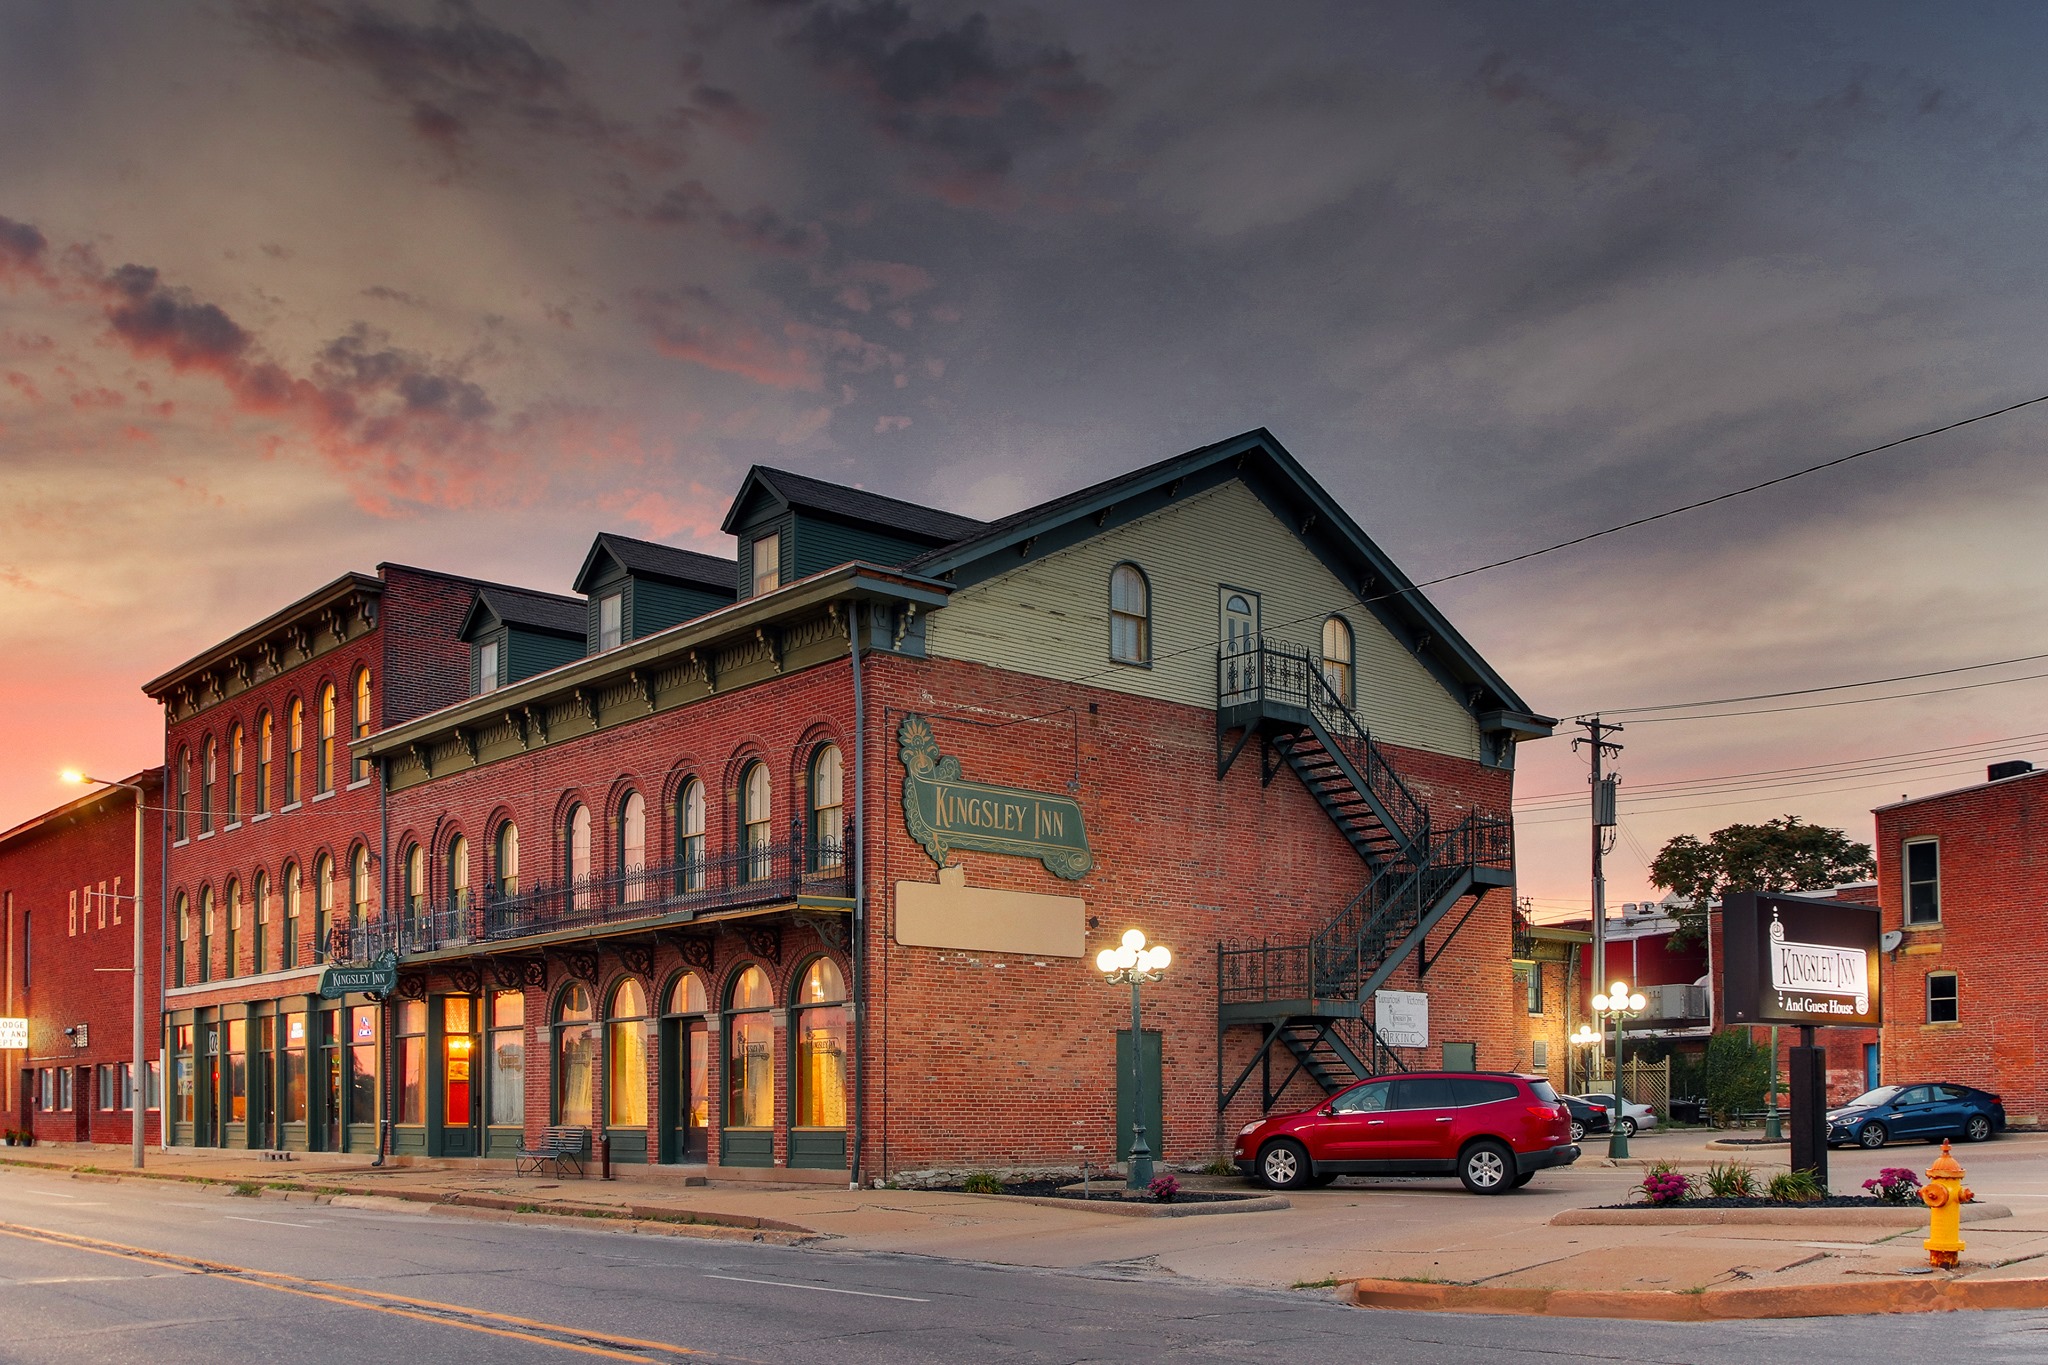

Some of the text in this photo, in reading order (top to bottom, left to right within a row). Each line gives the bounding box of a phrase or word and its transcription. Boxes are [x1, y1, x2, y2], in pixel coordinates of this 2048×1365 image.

[935, 786, 1064, 839] KINGSLEY INN
[68, 875, 122, 938] BPOE
[1780, 948, 1856, 988] KINGSLEY INN
[332, 971, 386, 987] KINGSLEY INN
[1785, 997, 1854, 1015] And Guest House
[10, 1030, 27, 1038] AND
[1389, 1032, 1416, 1043] RKING
